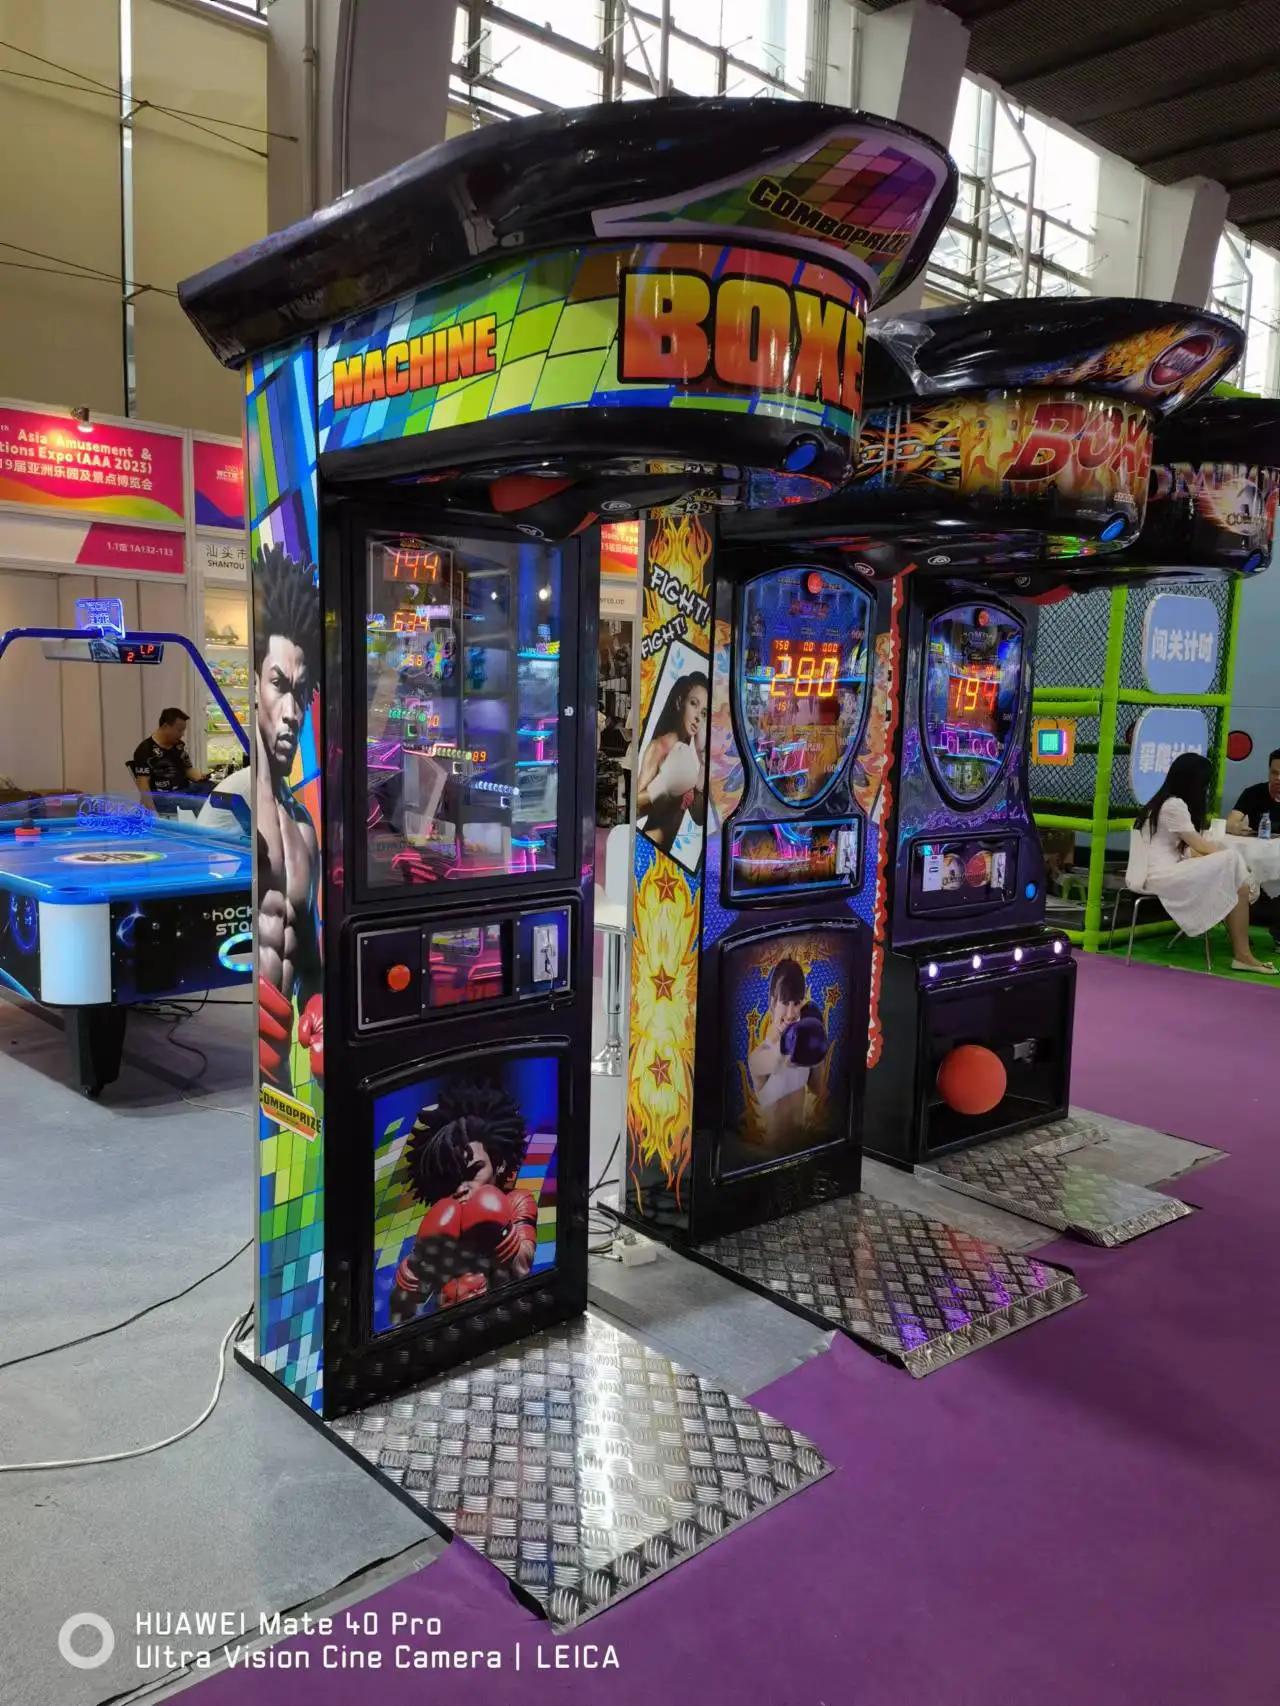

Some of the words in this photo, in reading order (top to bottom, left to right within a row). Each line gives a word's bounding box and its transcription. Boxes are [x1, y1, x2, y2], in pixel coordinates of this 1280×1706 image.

[749, 176, 912, 255] COMBOPRIZE
[333, 312, 497, 411] MACHINE
[18, 429, 47, 444] Asia
[56, 434, 133, 457] Amusement
[141, 448, 152, 460] &
[38, 446, 73, 464] Expo
[77, 452, 111, 468] (AAA
[207, 560, 245, 570] SHANTOU
[650, 564, 710, 626] FIGHT!
[641, 616, 687, 658] FIGHT!
[769, 655, 840, 698] 280
[472, 751, 487, 762] 89
